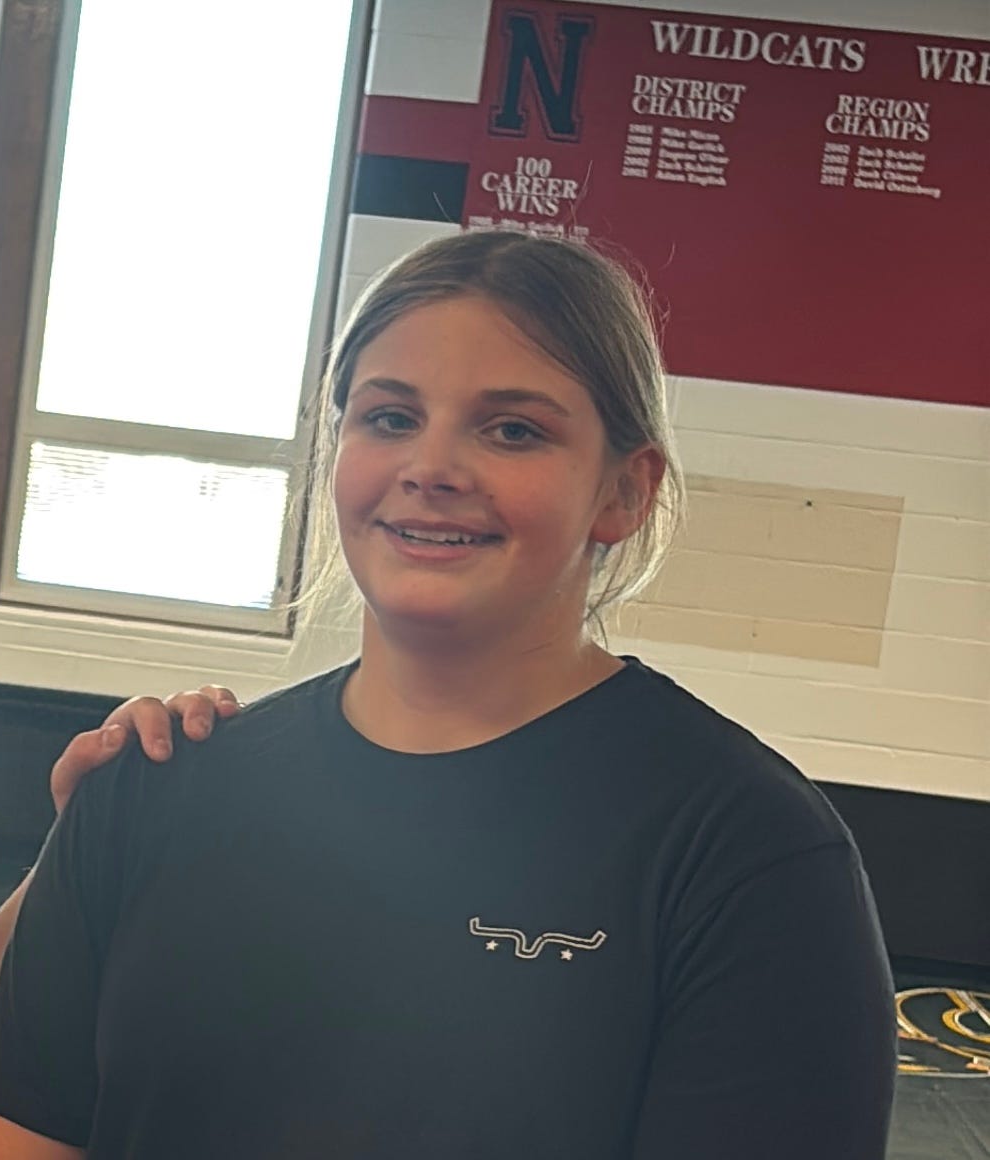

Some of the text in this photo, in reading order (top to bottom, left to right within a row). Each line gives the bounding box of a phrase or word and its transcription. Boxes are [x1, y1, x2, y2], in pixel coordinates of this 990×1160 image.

[650, 20, 866, 72] WILDCATS
[488, 8, 597, 143] N
[634, 74, 746, 104] DISTRICT
[631, 94, 737, 123] CHAMPS
[837, 94, 930, 122] REGION
[825, 113, 930, 142] CHAMPS
[515, 156, 552, 178] 100
[481, 172, 579, 200] CAREER
[496, 190, 561, 216] WINS
